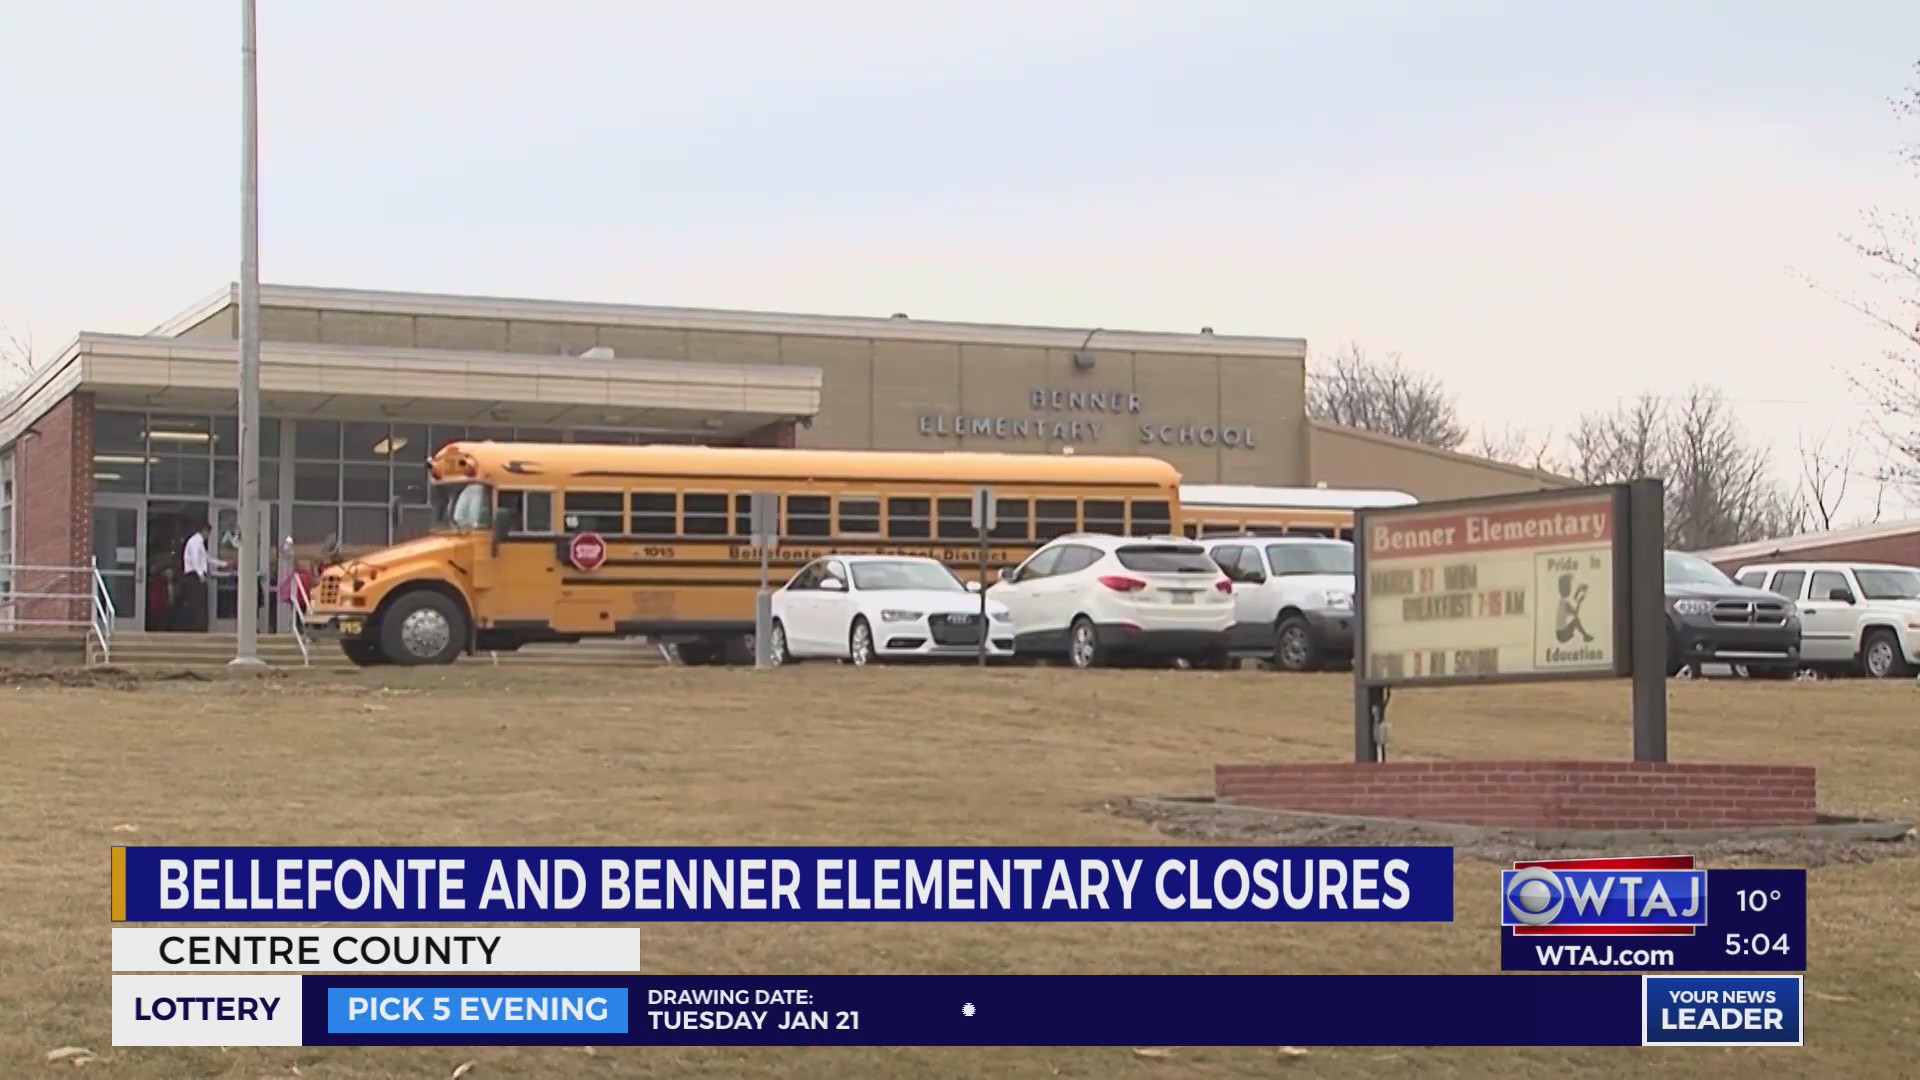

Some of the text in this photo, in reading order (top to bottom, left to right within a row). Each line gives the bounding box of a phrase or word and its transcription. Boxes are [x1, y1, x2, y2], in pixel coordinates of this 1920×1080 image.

[1031, 389, 1143, 414] BENNER
[919, 415, 1258, 450] ELEMENTARY SCHOOL
[1373, 511, 1606, 552] Benner Elementary
[575, 543, 602, 559] STOP
[1547, 556, 1579, 571] Pride
[1505, 590, 1525, 615] AM
[1546, 646, 1604, 664] Education
